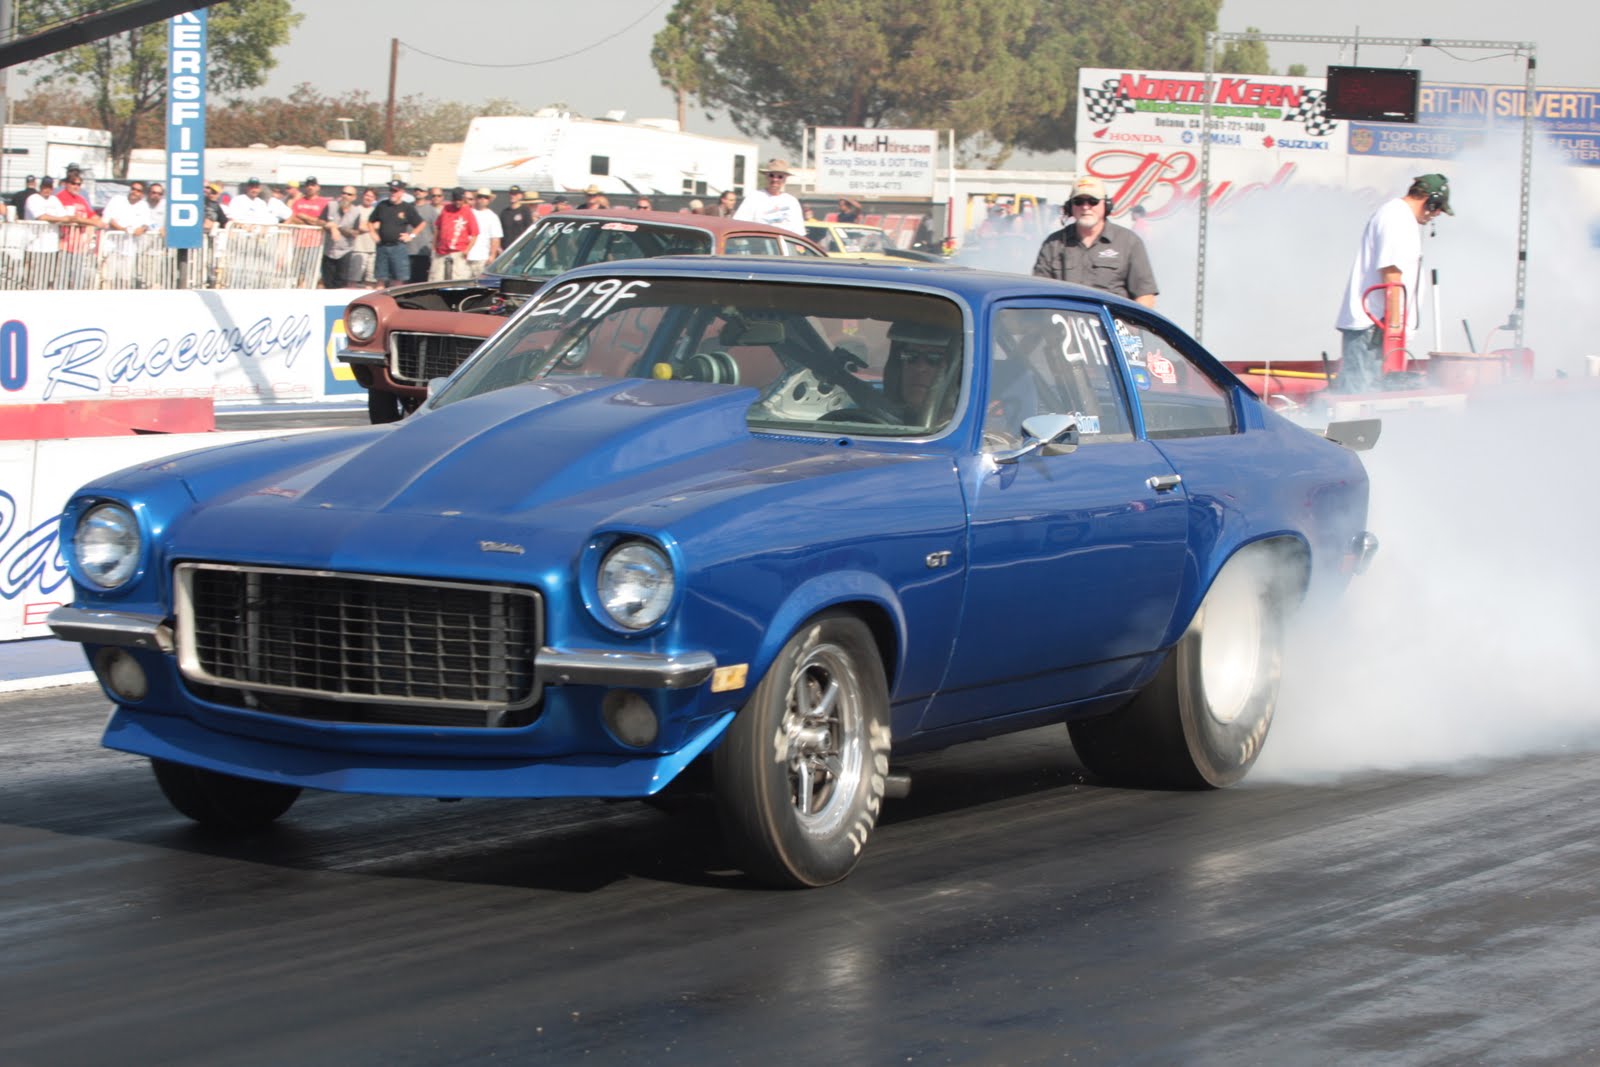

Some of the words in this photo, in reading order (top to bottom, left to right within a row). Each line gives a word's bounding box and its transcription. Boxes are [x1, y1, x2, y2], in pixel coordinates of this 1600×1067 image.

[1117, 73, 1217, 104] NORTH
[1216, 77, 1305, 108] KERN
[1109, 132, 1164, 143] HONDA
[1381, 130, 1414, 142] TOP
[1277, 138, 1329, 150] SUZUKI
[824, 157, 852, 167] Racing
[536, 222, 600, 236] 186F
[531, 278, 651, 319] 219F
[1051, 313, 1108, 366] 219F
[42, 314, 312, 400] Raceway
[926, 550, 952, 567] GT
